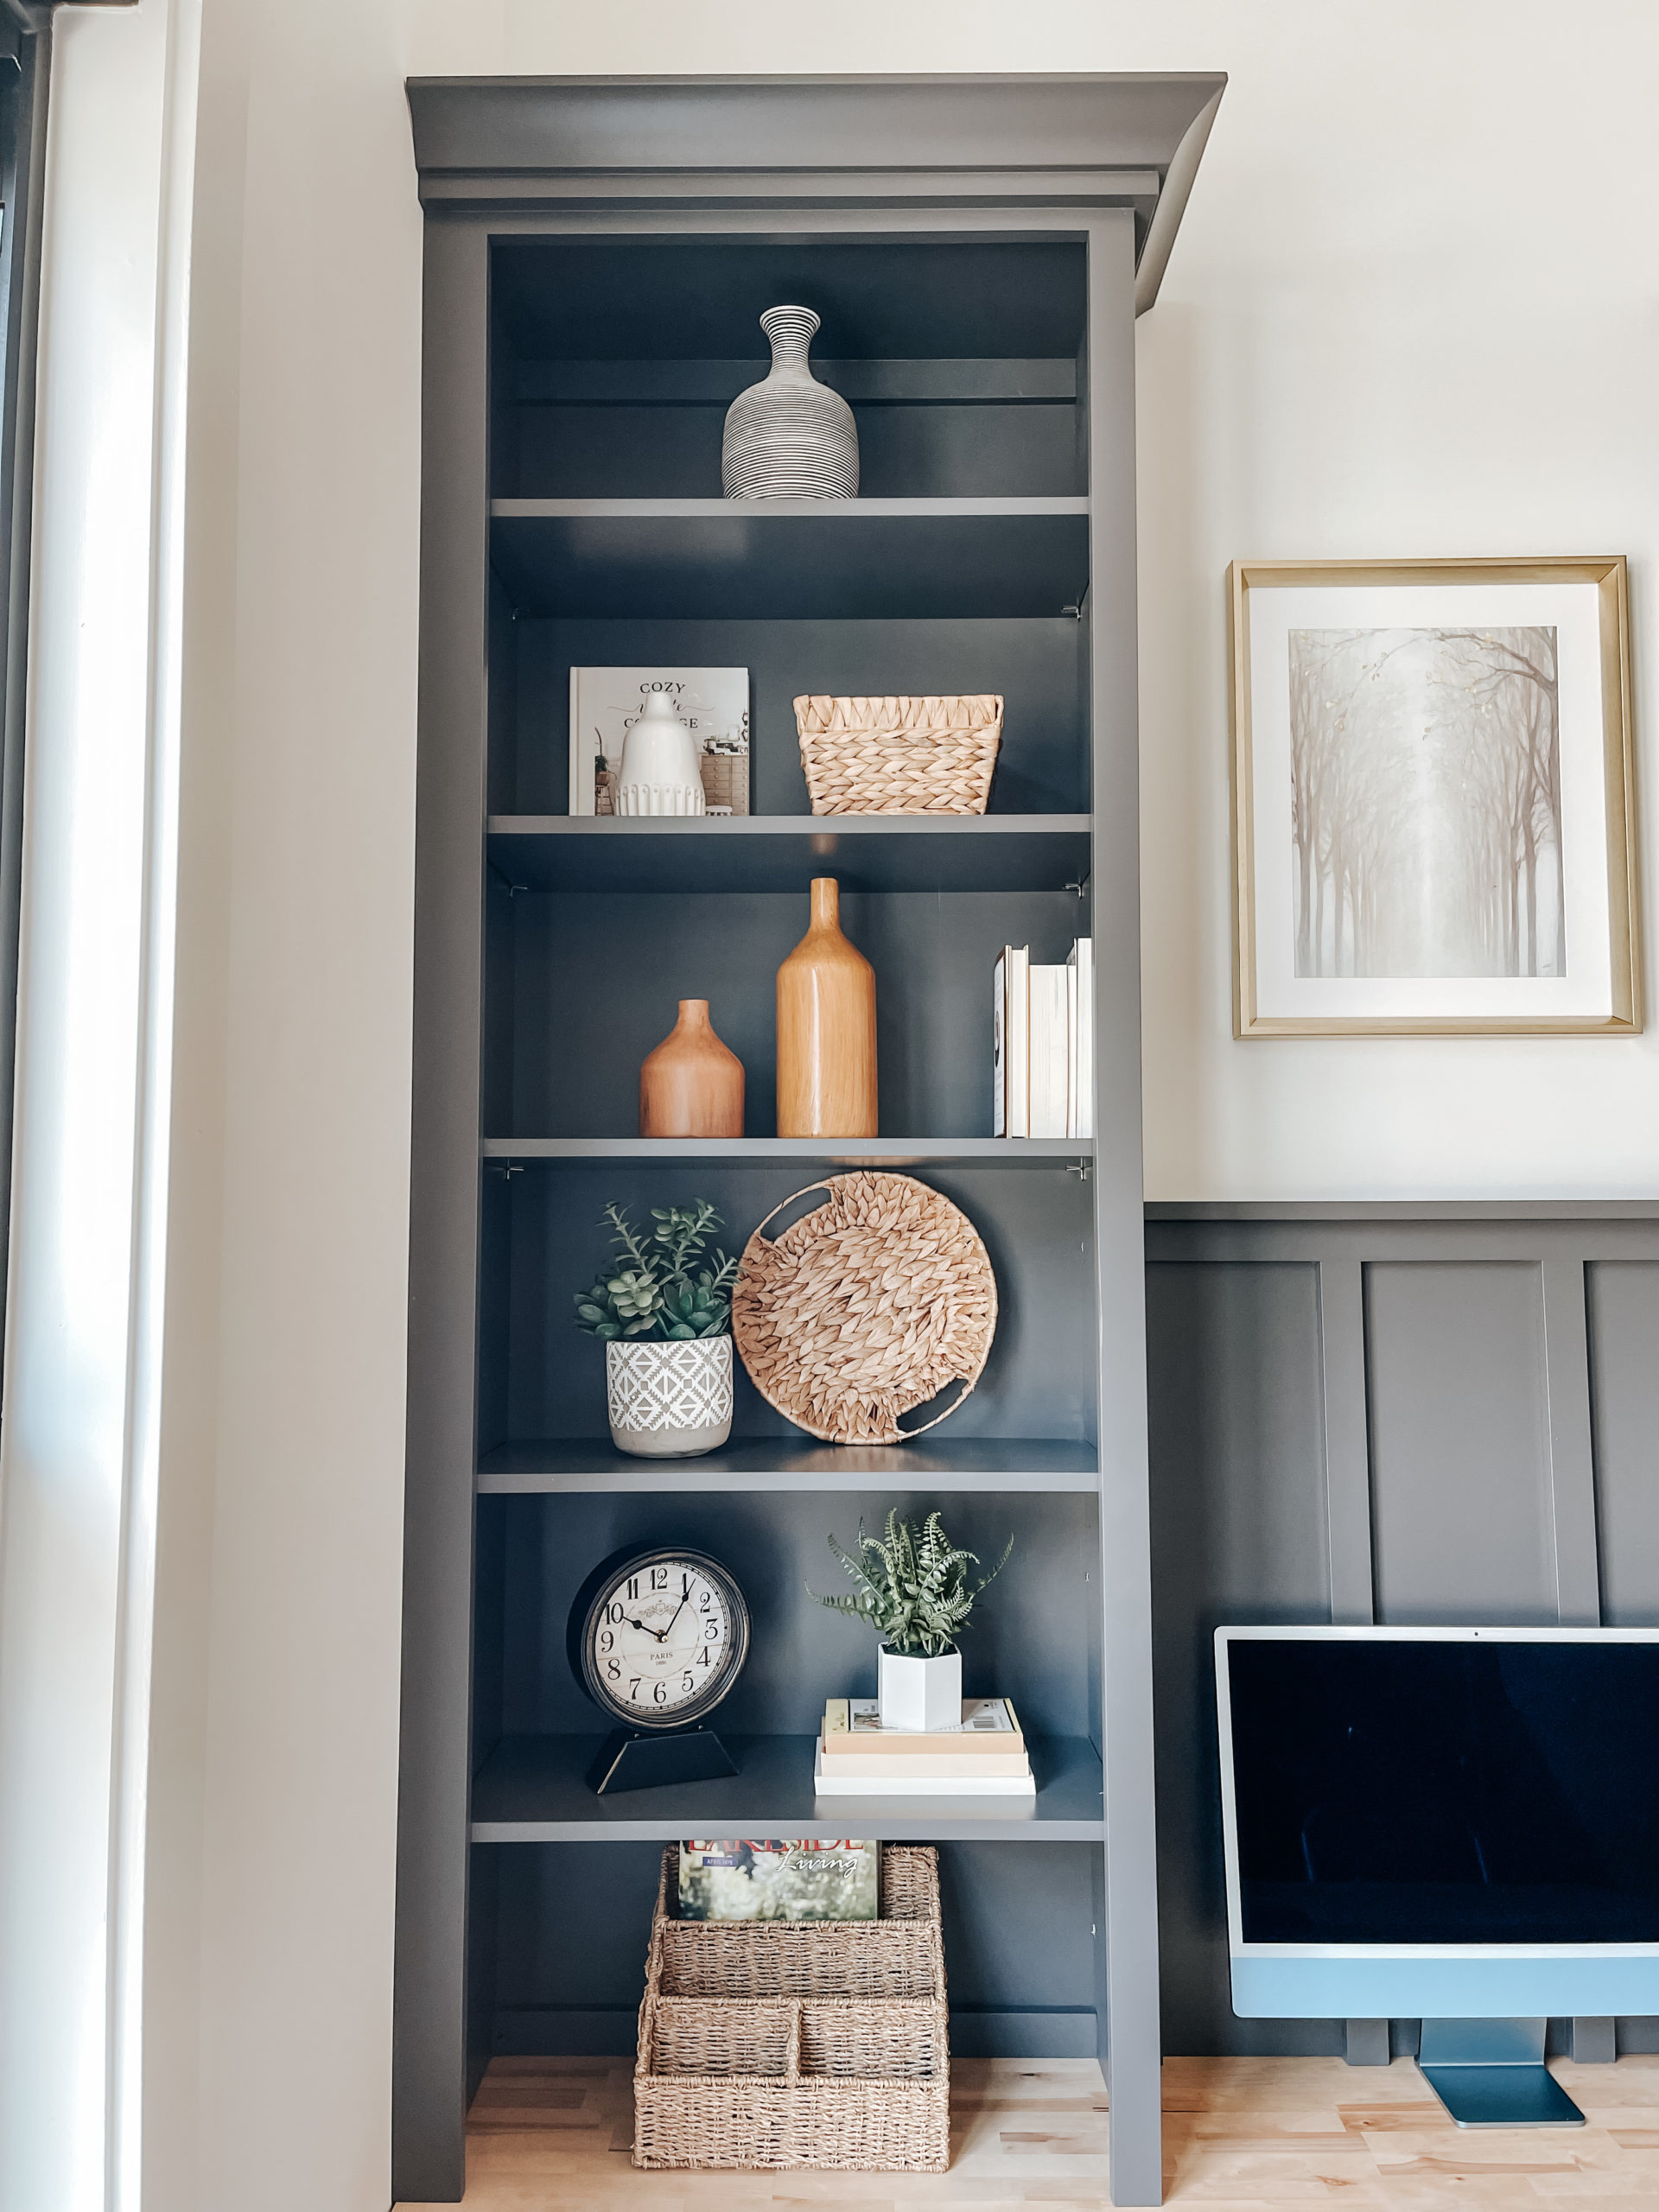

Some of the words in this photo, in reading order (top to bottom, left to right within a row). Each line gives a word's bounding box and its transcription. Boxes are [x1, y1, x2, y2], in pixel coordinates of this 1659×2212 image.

[639, 682, 686, 694] COZY
[626, 1578, 639, 1600] 11
[650, 1568, 668, 1590] 12
[681, 1573, 688, 1594] 1
[606, 1603, 624, 1624] 10
[699, 1592, 711, 1613] 2
[704, 1618, 718, 1640] 3
[601, 1630, 614, 1653] 9
[650, 1651, 673, 1660] PARIS
[696, 1646, 711, 1667] 4
[607, 1658, 621, 1680] 8
[629, 1677, 642, 1700] 7
[653, 1681, 667, 1703] 6
[681, 1670, 694, 1693] 5
[774, 1846, 858, 1878] Living
